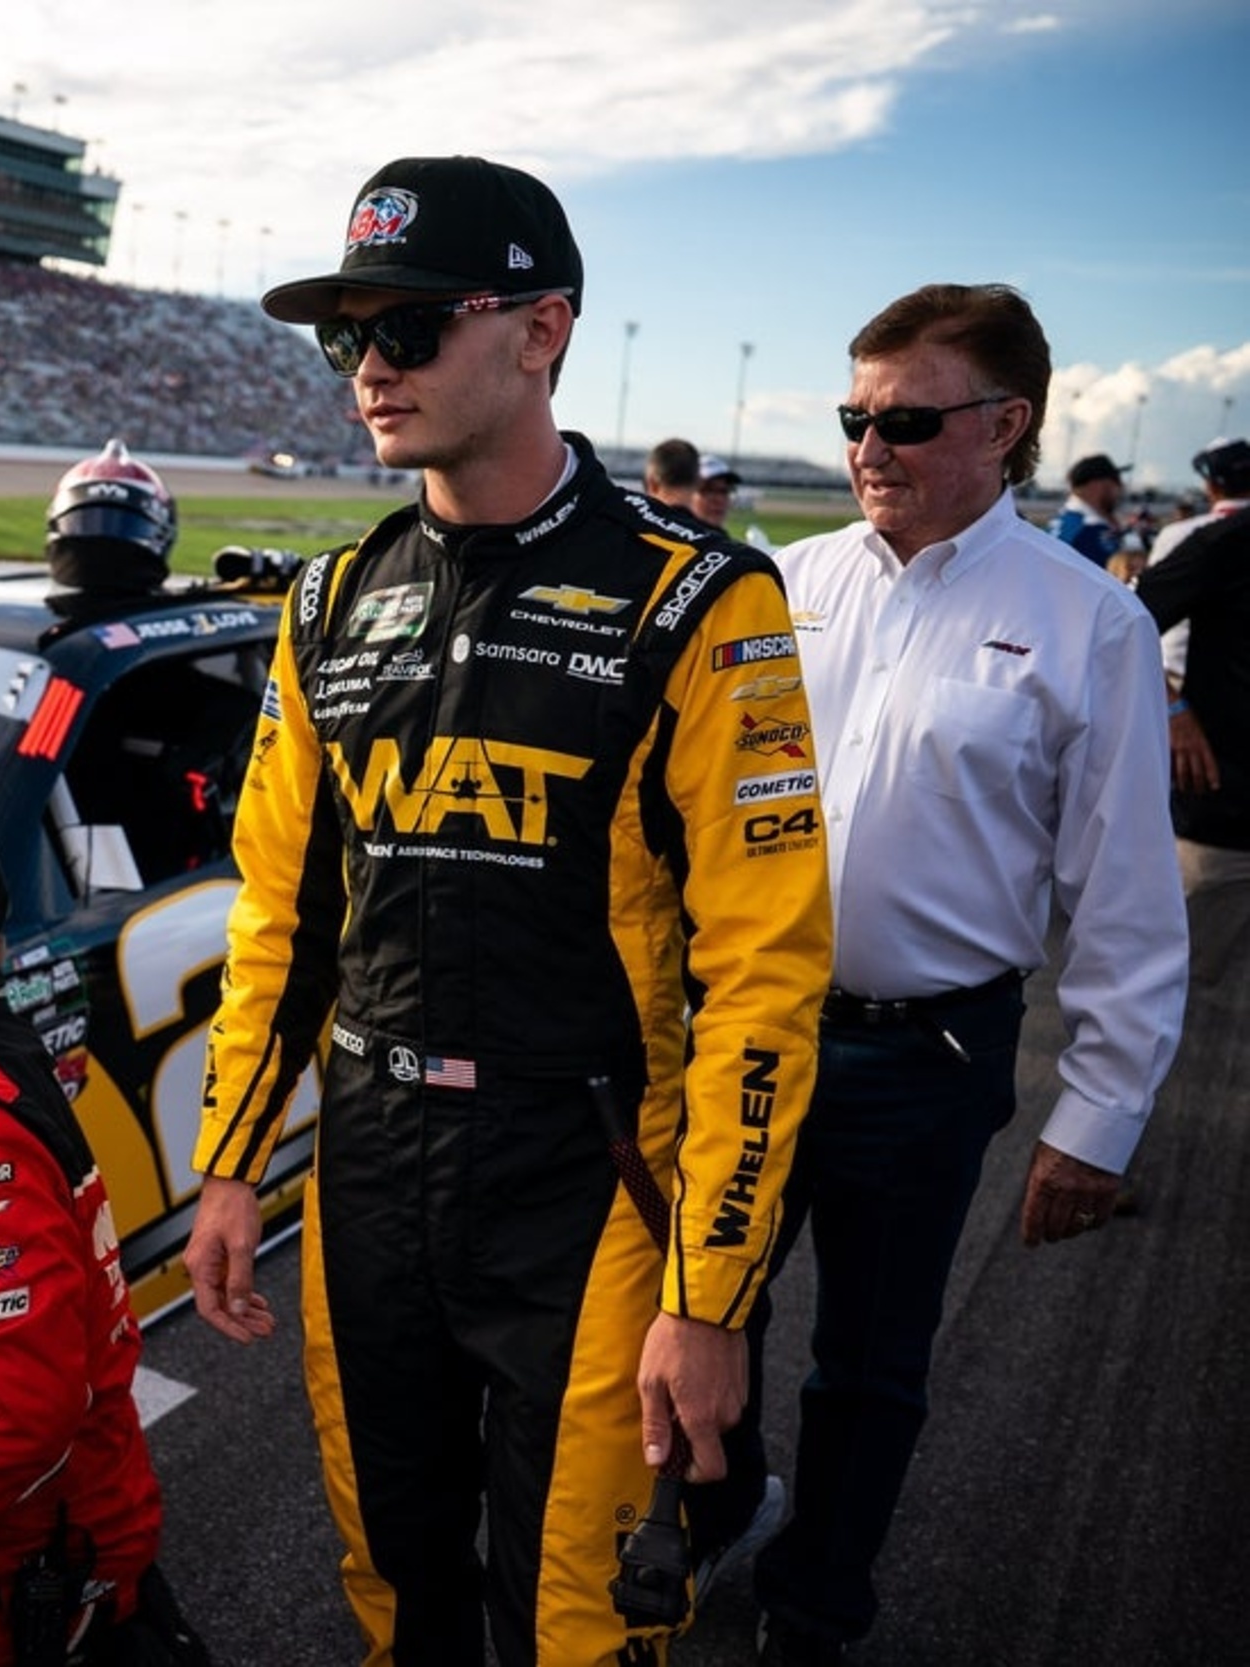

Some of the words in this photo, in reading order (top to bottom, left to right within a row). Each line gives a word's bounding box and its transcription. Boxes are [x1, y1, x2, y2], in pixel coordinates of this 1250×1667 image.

[655, 551, 731, 630] sparco
[510, 609, 627, 638] CHEVROLET
[475, 641, 561, 666] samsara
[568, 652, 628, 678] DWC
[738, 724, 806, 748] SUNOCO
[326, 736, 595, 845] WAT
[737, 776, 815, 800] COMETIC
[744, 808, 819, 844] C4
[460, 849, 546, 869] TECHNOLOGIES
[703, 1047, 781, 1249] WHELEN
